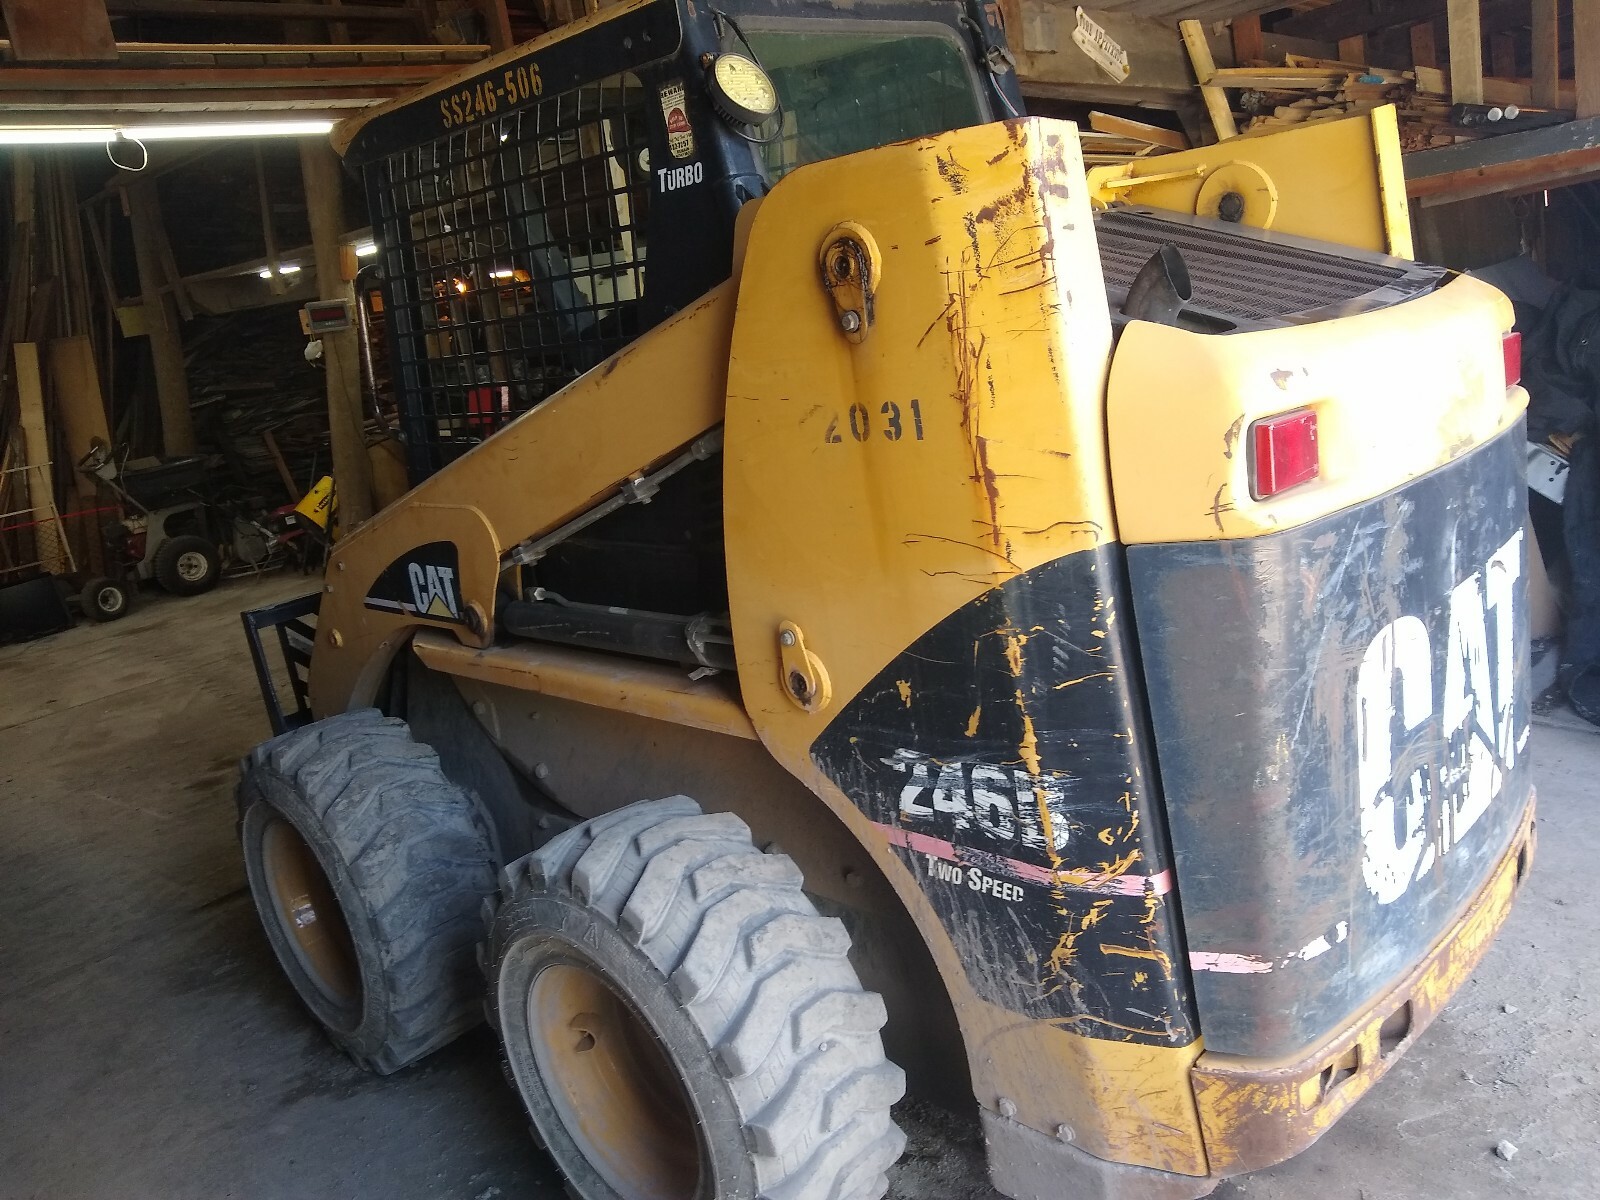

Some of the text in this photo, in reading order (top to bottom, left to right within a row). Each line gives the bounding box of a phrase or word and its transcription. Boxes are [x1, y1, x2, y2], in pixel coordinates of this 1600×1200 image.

[440, 62, 543, 129] SS246-506
[657, 161, 703, 193] TURBO
[824, 398, 924, 443] 2031
[408, 562, 459, 619] CAT
[1356, 527, 1525, 905] CAT
